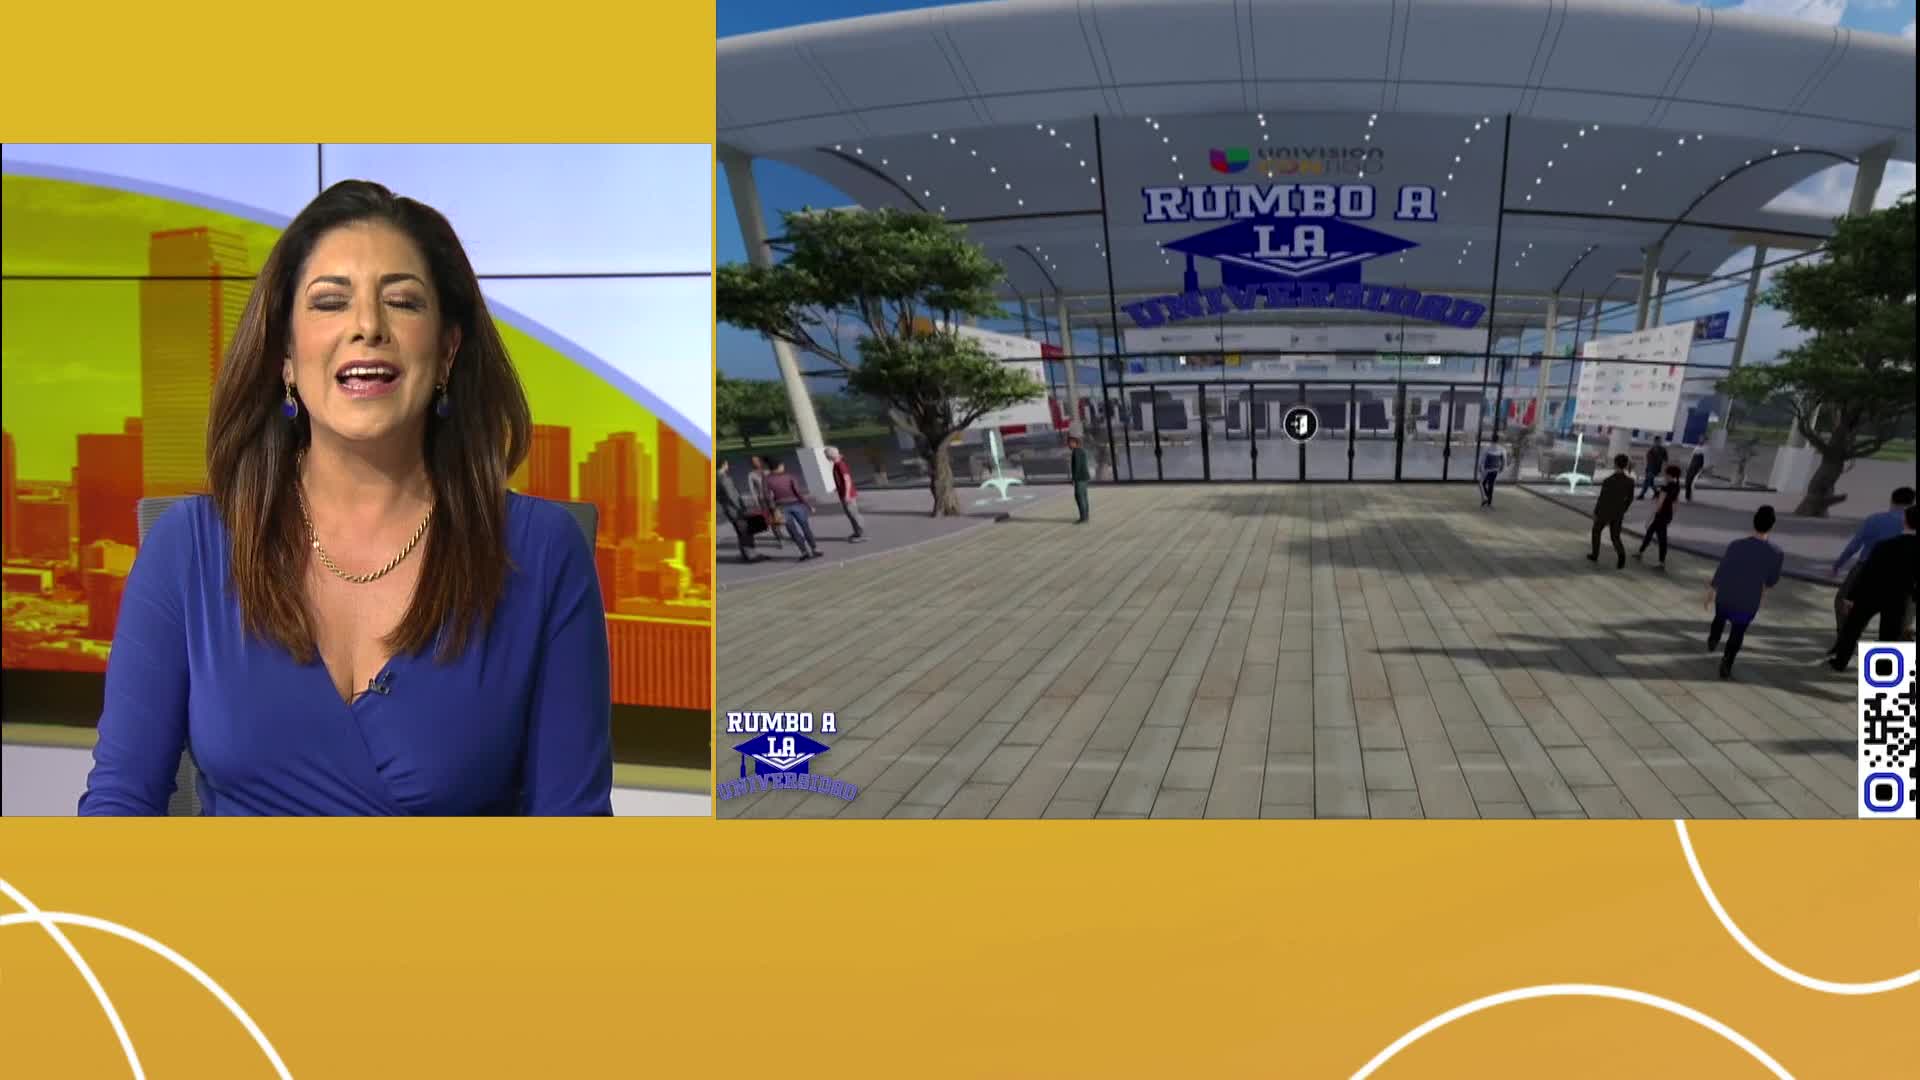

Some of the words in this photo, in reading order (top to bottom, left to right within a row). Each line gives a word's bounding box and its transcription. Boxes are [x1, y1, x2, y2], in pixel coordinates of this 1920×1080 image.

[1143, 184, 1375, 222] RUMBO
[1395, 184, 1438, 222] A
[1253, 225, 1328, 258] LA
[1121, 282, 1486, 328] UNIVERSIDAD
